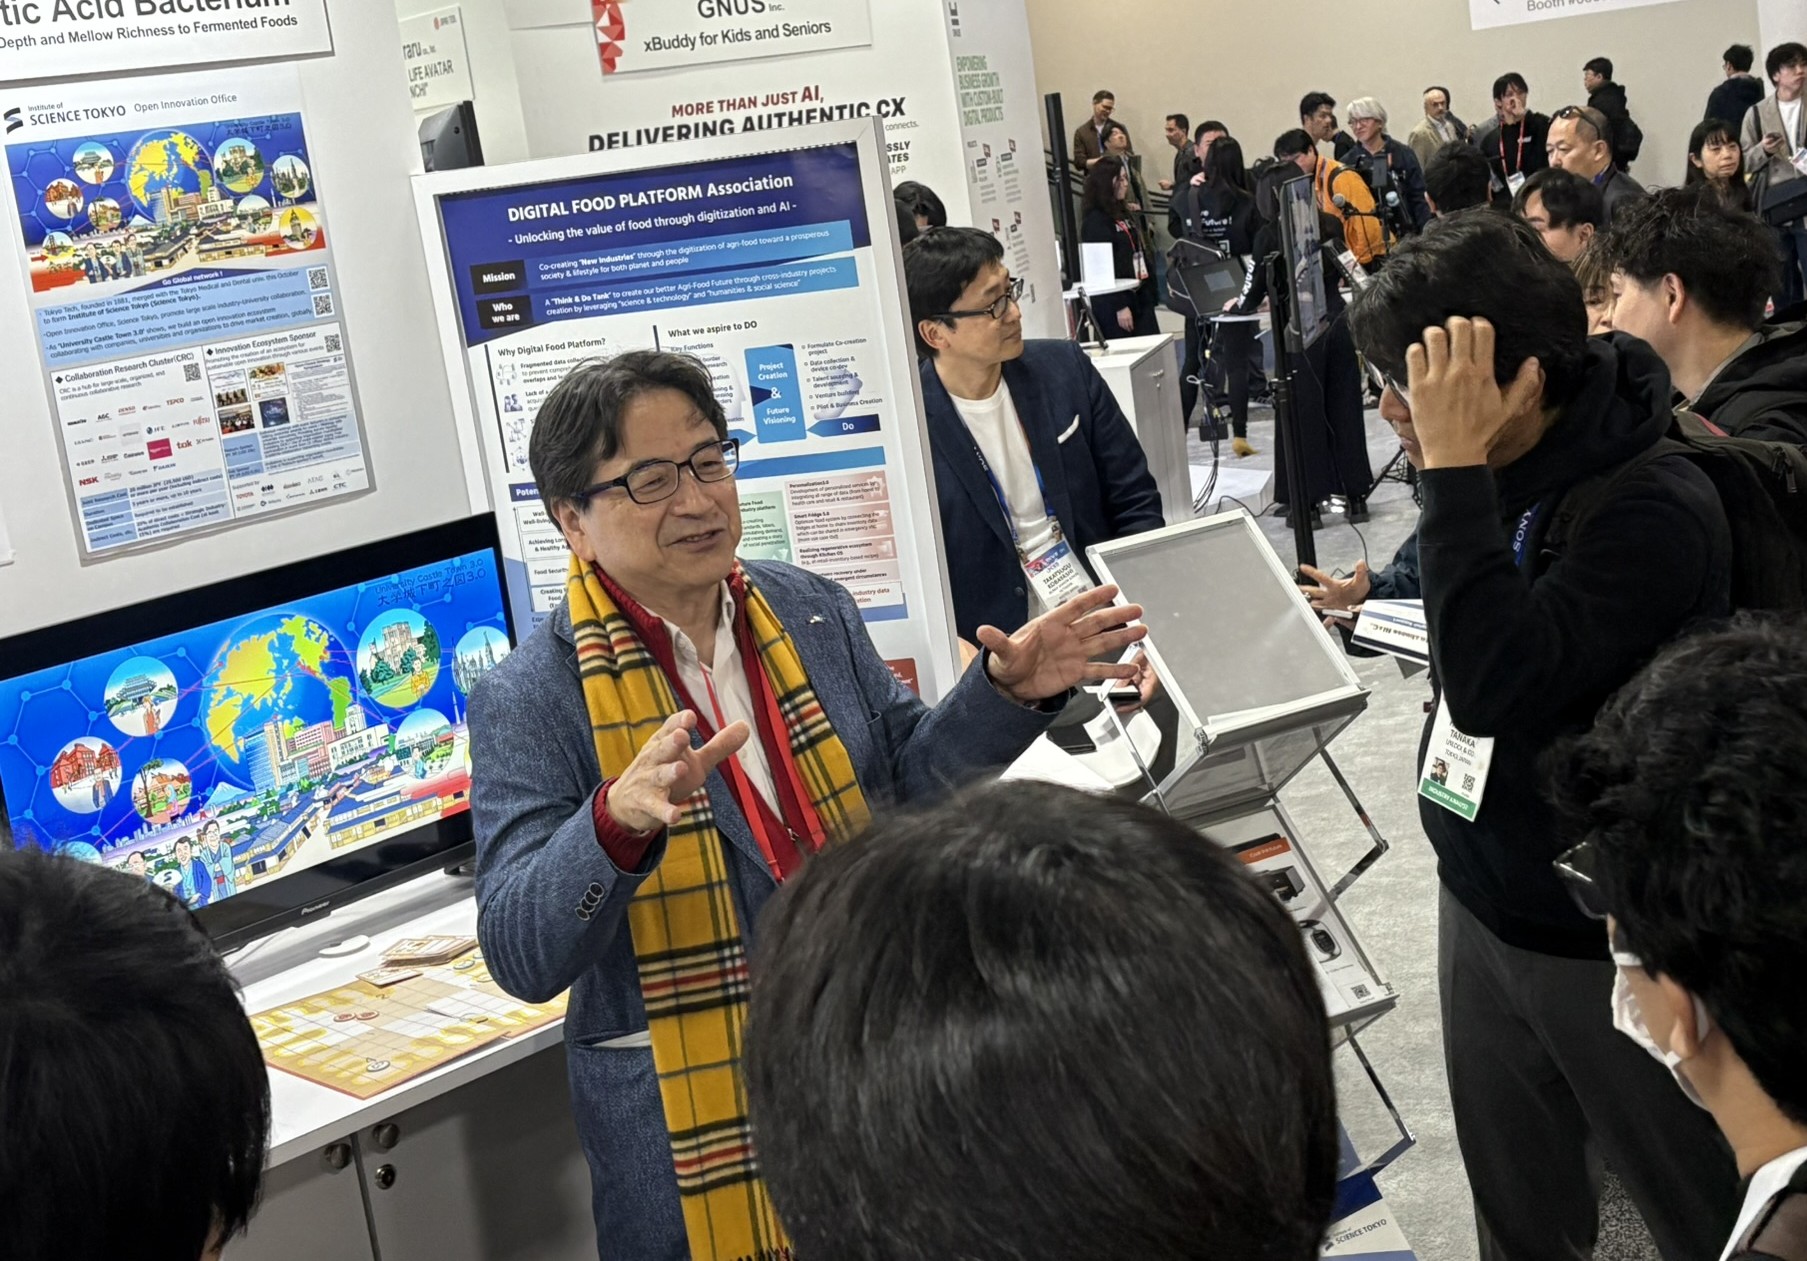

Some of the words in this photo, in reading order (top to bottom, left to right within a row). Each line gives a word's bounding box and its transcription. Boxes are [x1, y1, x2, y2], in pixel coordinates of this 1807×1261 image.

[698, 0, 766, 18] GNUS
[769, 3, 785, 12] Inc.
[0, 35, 36, 50] Depth
[40, 32, 65, 46] and
[68, 30, 113, 43] Mellow
[116, 24, 176, 40] Richness
[178, 24, 190, 34] to
[193, 18, 258, 34] Fermented
[260, 14, 298, 28] Foods
[644, 34, 696, 52] xBuddy
[700, 32, 718, 46] for
[722, 28, 752, 44] Kids
[756, 24, 780, 40] and
[782, 20, 832, 36] Seniors
[408, 66, 424, 82] LIFE
[424, 60, 454, 78] AVATAR
[56, 102, 63, 110] of
[134, 103, 159, 114] Open
[161, 97, 208, 109] Innovation
[210, 94, 238, 104] Office
[672, 102, 714, 118] MORE
[718, 97, 758, 112] THAN
[762, 92, 798, 106] JUST
[801, 86, 824, 103] AI,
[30, 110, 82, 126] SCIENCE
[83, 105, 126, 120] TOKYO
[589, 118, 735, 152] DELIVERING
[742, 102, 870, 134] AUTHENTIC
[876, 97, 906, 118] CX
[885, 120, 920, 131] connects.
[508, 202, 568, 222] DIGITAL
[572, 196, 616, 214] FOOD
[620, 184, 702, 208] PLATFORM
[706, 175, 793, 197] Association
[514, 230, 564, 244] Unlocking
[567, 227, 584, 238] the
[586, 222, 612, 234] value
[615, 220, 626, 231] of
[628, 218, 652, 230] food
[654, 214, 695, 228] through
[697, 204, 756, 224] digitization
[758, 203, 776, 214] and
[780, 202, 790, 212] AI
[538, 260, 578, 270] Co-creating
[636, 250, 664, 260] through
[678, 244, 716, 256] digitization
[726, 238, 758, 248] agri-food
[759, 236, 784, 244] toward
[790, 230, 830, 241] prosperous
[540, 272, 564, 280] society
[572, 267, 598, 276] lifestyle
[611, 264, 628, 272] both
[628, 262, 650, 270] planet
[666, 257, 688, 266] people
[482, 272, 516, 284] Mission
[582, 294, 592, 302] Do
[656, 285, 676, 293] better
[678, 282, 710, 291] Agri-Food
[711, 278, 732, 286] Future
[734, 274, 760, 284] through
[762, 271, 807, 280] cross-industry
[809, 266, 836, 276] projects
[492, 302, 513, 312] Who
[546, 306, 572, 316] creation
[584, 302, 618, 312] leveraging
[492, 315, 505, 324] we
[506, 314, 520, 322] are
[668, 330, 690, 338] What
[706, 325, 732, 334] aspire
[744, 320, 758, 330] DO
[215, 344, 251, 354] Innovation
[252, 337, 288, 348] Ecosystem
[289, 332, 316, 343] Sponsor
[498, 348, 516, 356] Why
[518, 345, 544, 355] Digital
[546, 342, 566, 352] Food
[568, 338, 606, 348] Platform?
[684, 342, 714, 350] Functions
[65, 368, 114, 382] Collaboration
[114, 362, 148, 374] Research
[758, 370, 788, 381] Creation
[759, 362, 784, 372] Project
[770, 388, 782, 398] &
[766, 406, 790, 416] Future
[763, 416, 796, 426] Visioning
[842, 422, 854, 430] Do
[79, 476, 99, 486] NSK
[417, 572, 442, 582] Castle
[444, 564, 468, 574] Town
[470, 558, 484, 568] 3.0
[1450, 730, 1476, 748] TANAKA
[1336, 1228, 1362, 1244] SCIENCE
[1362, 1218, 1387, 1232] TOKYO
